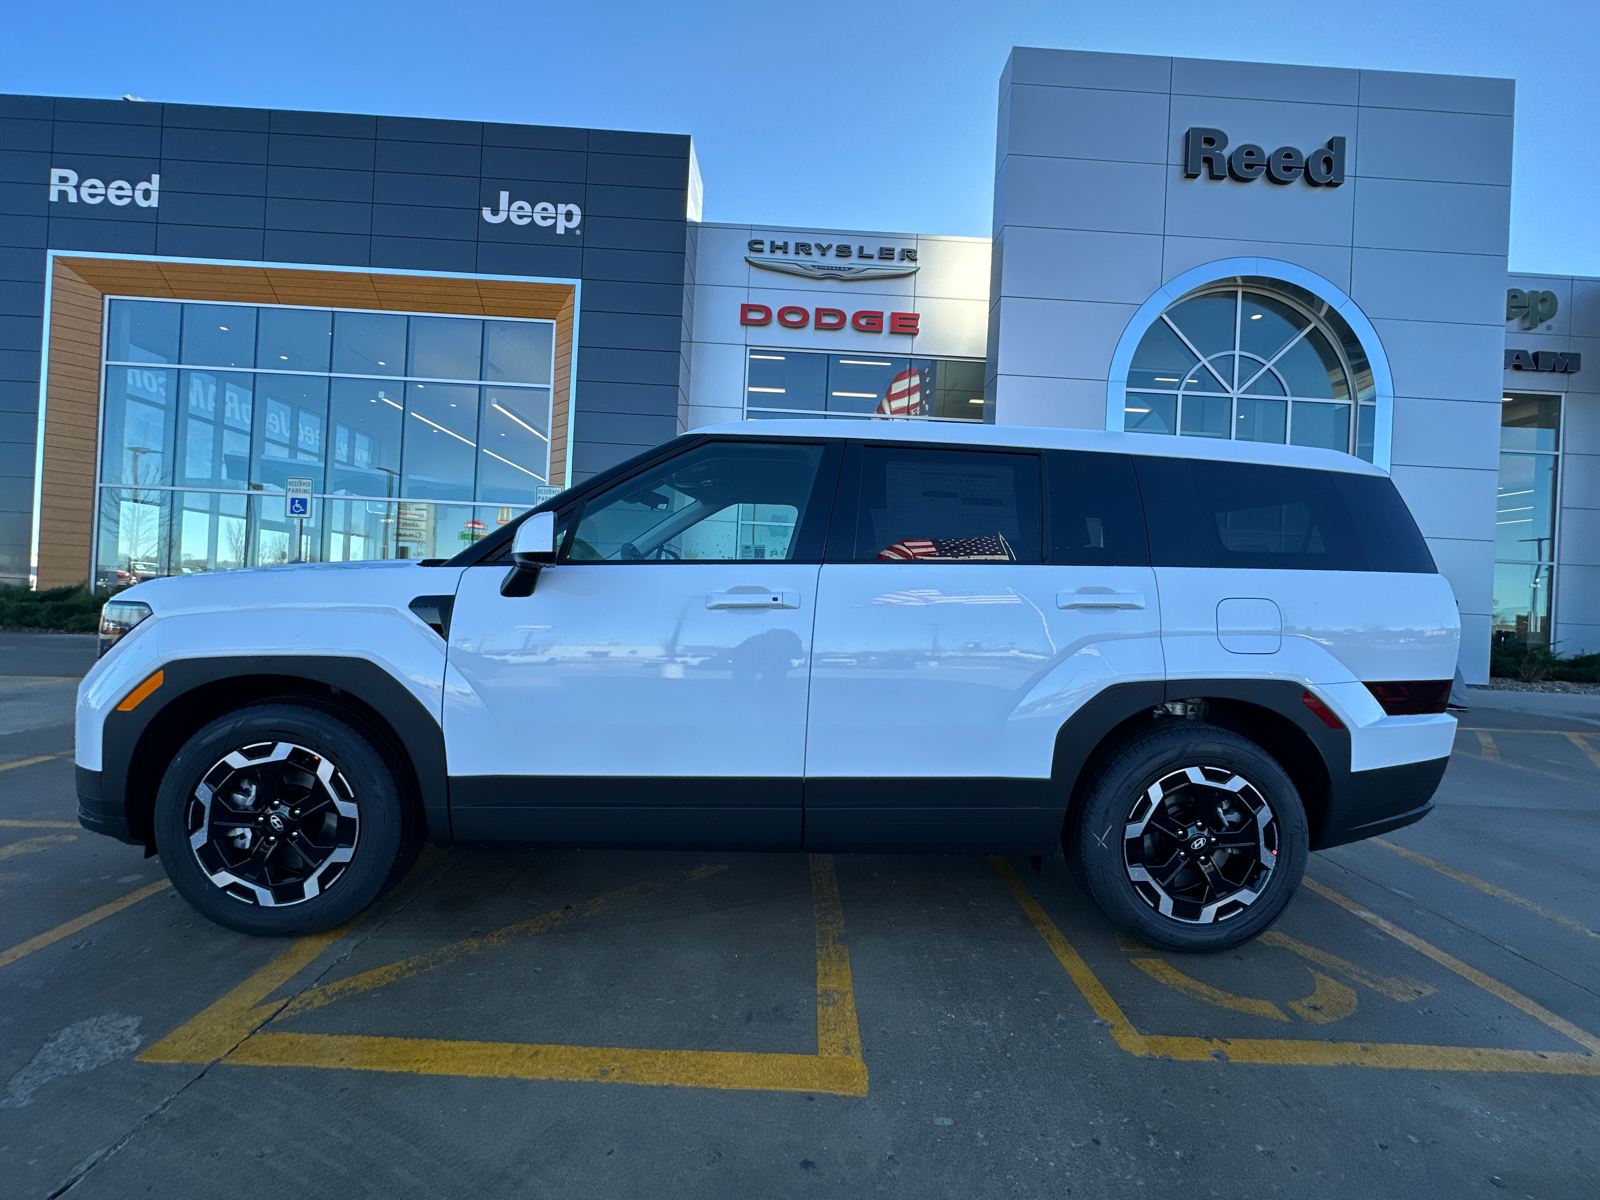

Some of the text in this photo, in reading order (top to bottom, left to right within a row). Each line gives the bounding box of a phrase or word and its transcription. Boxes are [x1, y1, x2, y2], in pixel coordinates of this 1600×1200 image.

[1184, 127, 1346, 187] Reed
[49, 168, 160, 208] Reed
[482, 190, 582, 235] Jeep
[747, 239, 918, 261] CHRYSLER
[740, 303, 920, 335] DODGE
[1506, 288, 1558, 331] ep
[1504, 349, 1581, 374] AM
